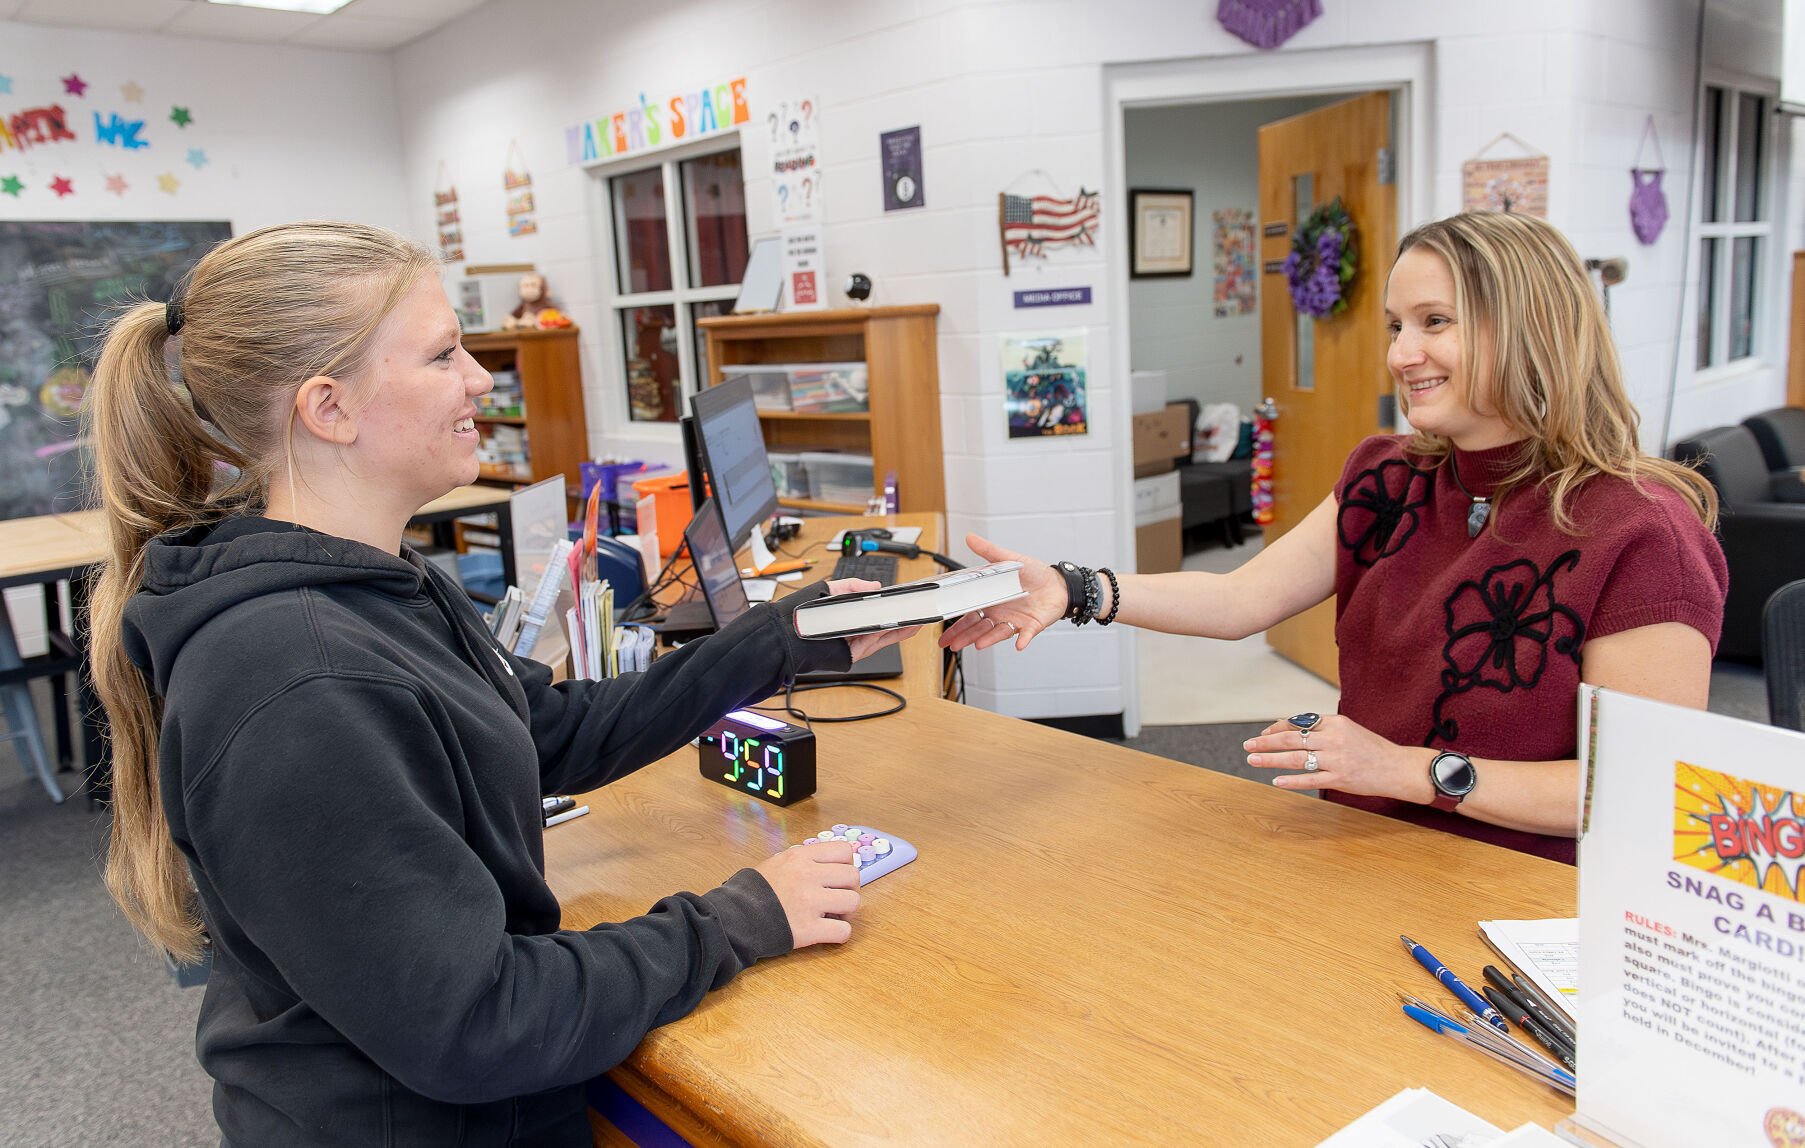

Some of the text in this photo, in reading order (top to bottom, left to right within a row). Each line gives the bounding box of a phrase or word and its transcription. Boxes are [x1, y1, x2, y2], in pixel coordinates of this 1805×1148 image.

[565, 77, 751, 164] MAKER'S SPACE
[721, 730, 784, 799] 9:59
[1708, 808, 1805, 859] BING
[1667, 871, 1744, 911] SNAG
[1756, 903, 1775, 923] A
[1624, 927, 1658, 945] must
[1664, 942, 1699, 961] mark
[1705, 959, 1725, 972] off
[1731, 967, 1755, 983] the
[1625, 910, 1677, 938] RULES:
[1682, 932, 1712, 952] Mrs.
[1714, 916, 1803, 961] CARD!
[1623, 969, 1676, 996] vertical
[1681, 994, 1695, 1004] or
[1701, 999, 1778, 1040] horizontal
[1624, 941, 1652, 958] also
[1658, 954, 1693, 974] must
[1698, 971, 1740, 992] prove
[1746, 990, 1774, 1007] you
[1624, 955, 1676, 982] square.
[1681, 977, 1723, 1000] Bingo
[1727, 996, 1740, 1009] is
[1623, 983, 1795, 1063] does NOT count). After
[1623, 997, 1647, 1013] you
[1651, 1009, 1676, 1026] will
[1682, 1021, 1699, 1036] be
[1704, 1031, 1756, 1061] invited
[1762, 1057, 1778, 1071] to
[1623, 1009, 1755, 1076] held in December!
